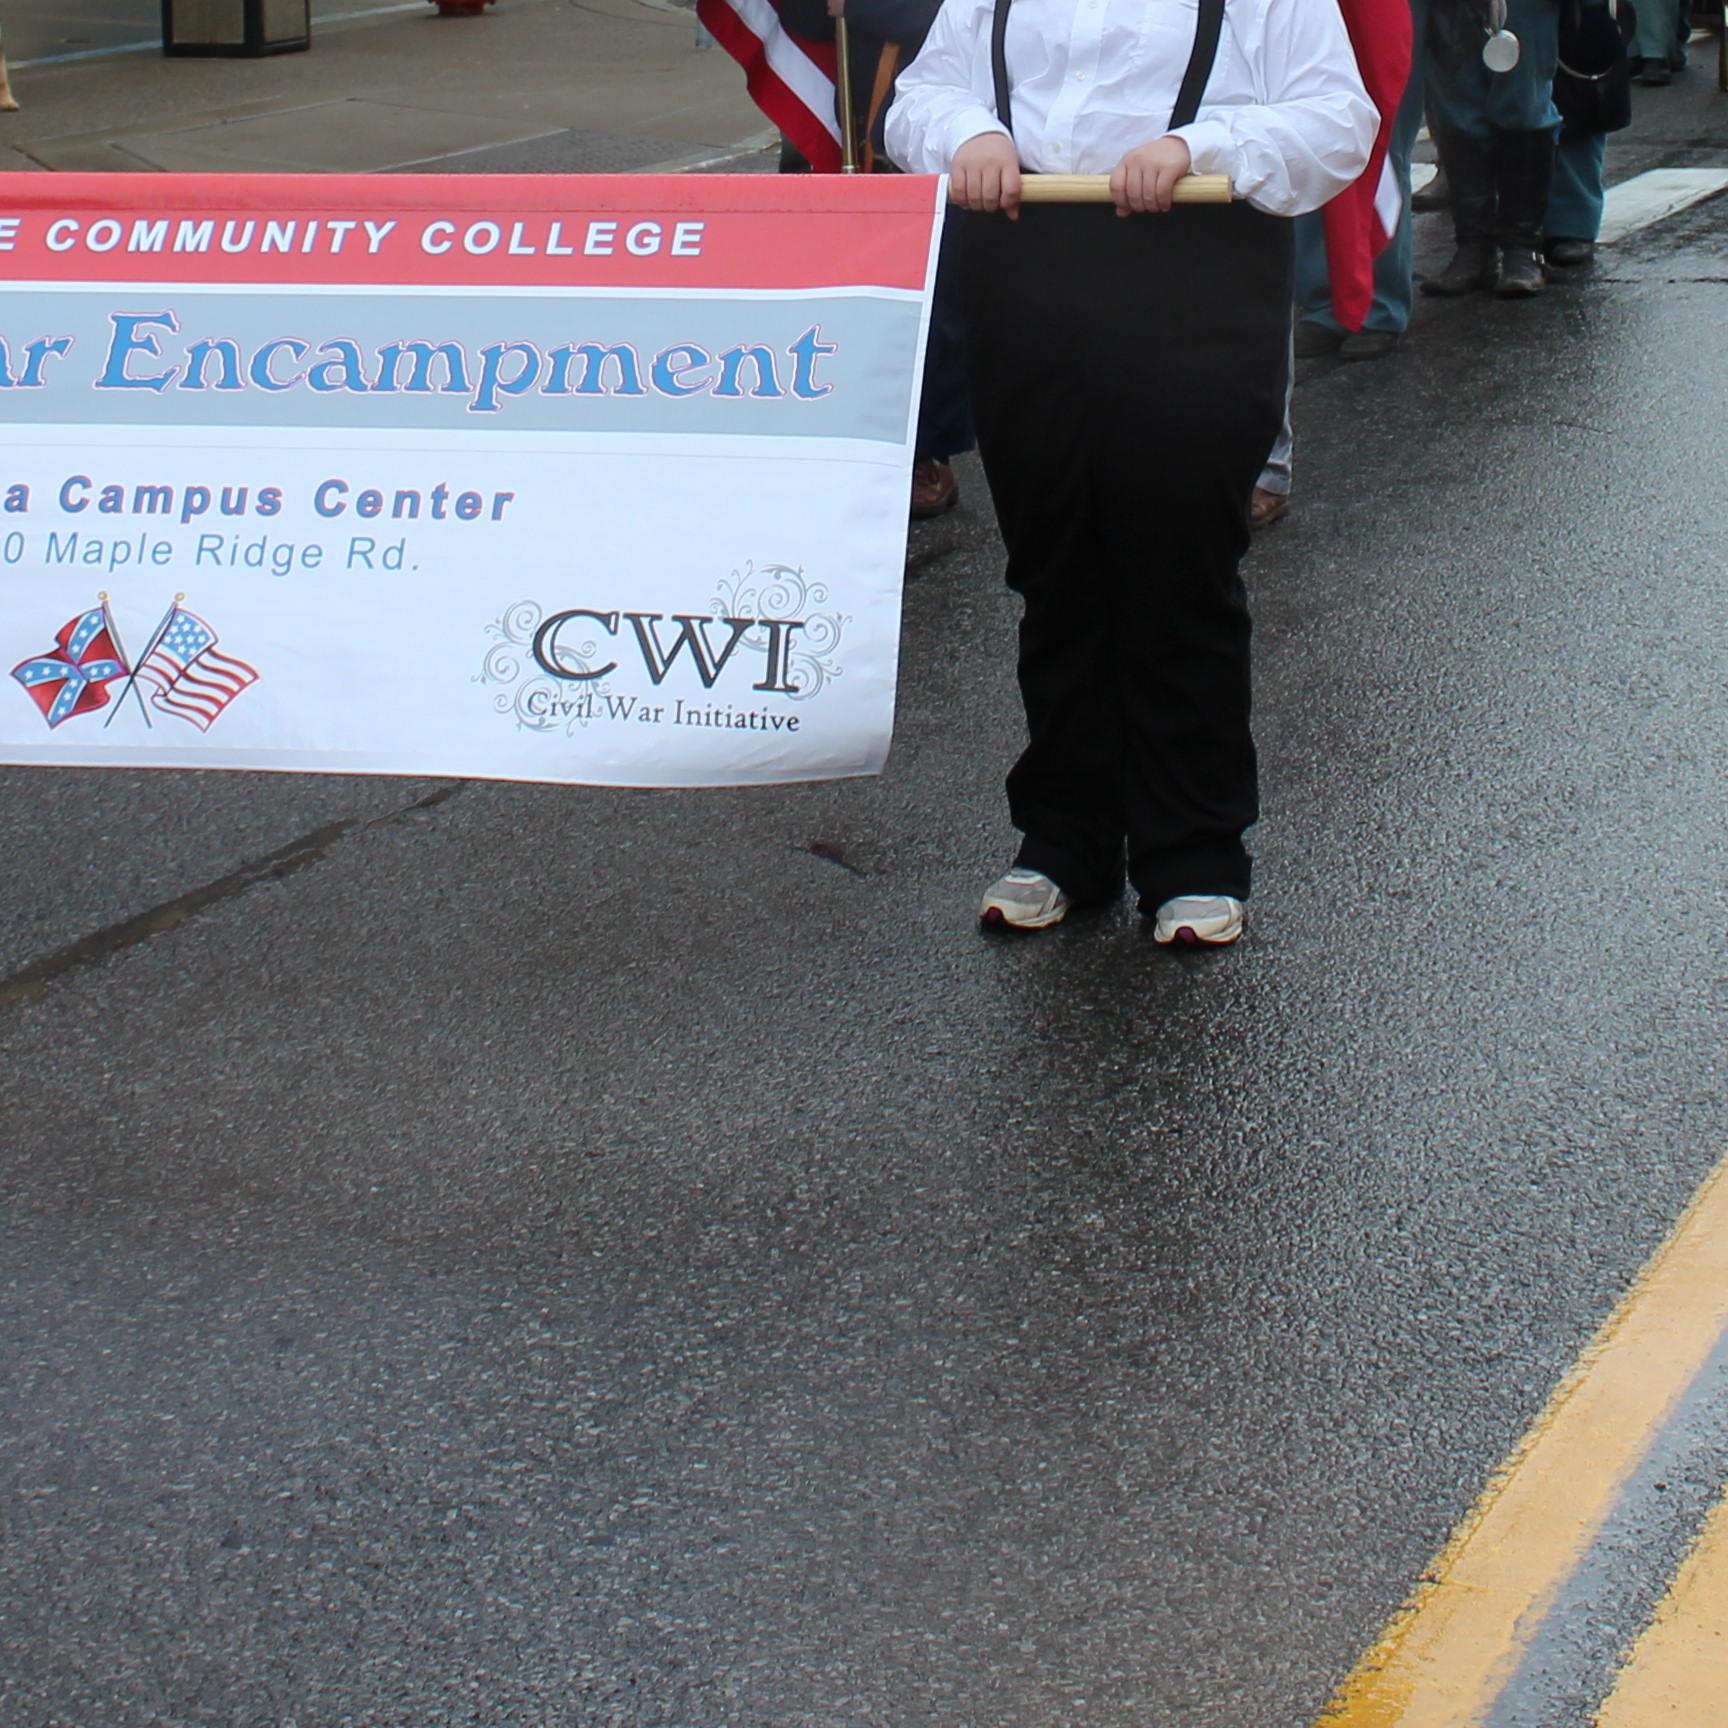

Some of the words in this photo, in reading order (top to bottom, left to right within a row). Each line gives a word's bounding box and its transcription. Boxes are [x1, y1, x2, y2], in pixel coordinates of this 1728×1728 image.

[44, 217, 398, 255] COMMUNITY
[421, 219, 707, 258] COLLEGE
[92, 308, 839, 414] Encampment
[58, 475, 285, 524] Campus
[314, 478, 515, 522] Center
[45, 531, 175, 574] Maple
[195, 533, 325, 577] Ridge
[346, 536, 421, 571] Rd.
[532, 608, 806, 693] CWI
[526, 689, 595, 720] Civil
[605, 693, 665, 724] War
[672, 698, 801, 734] Initiative
